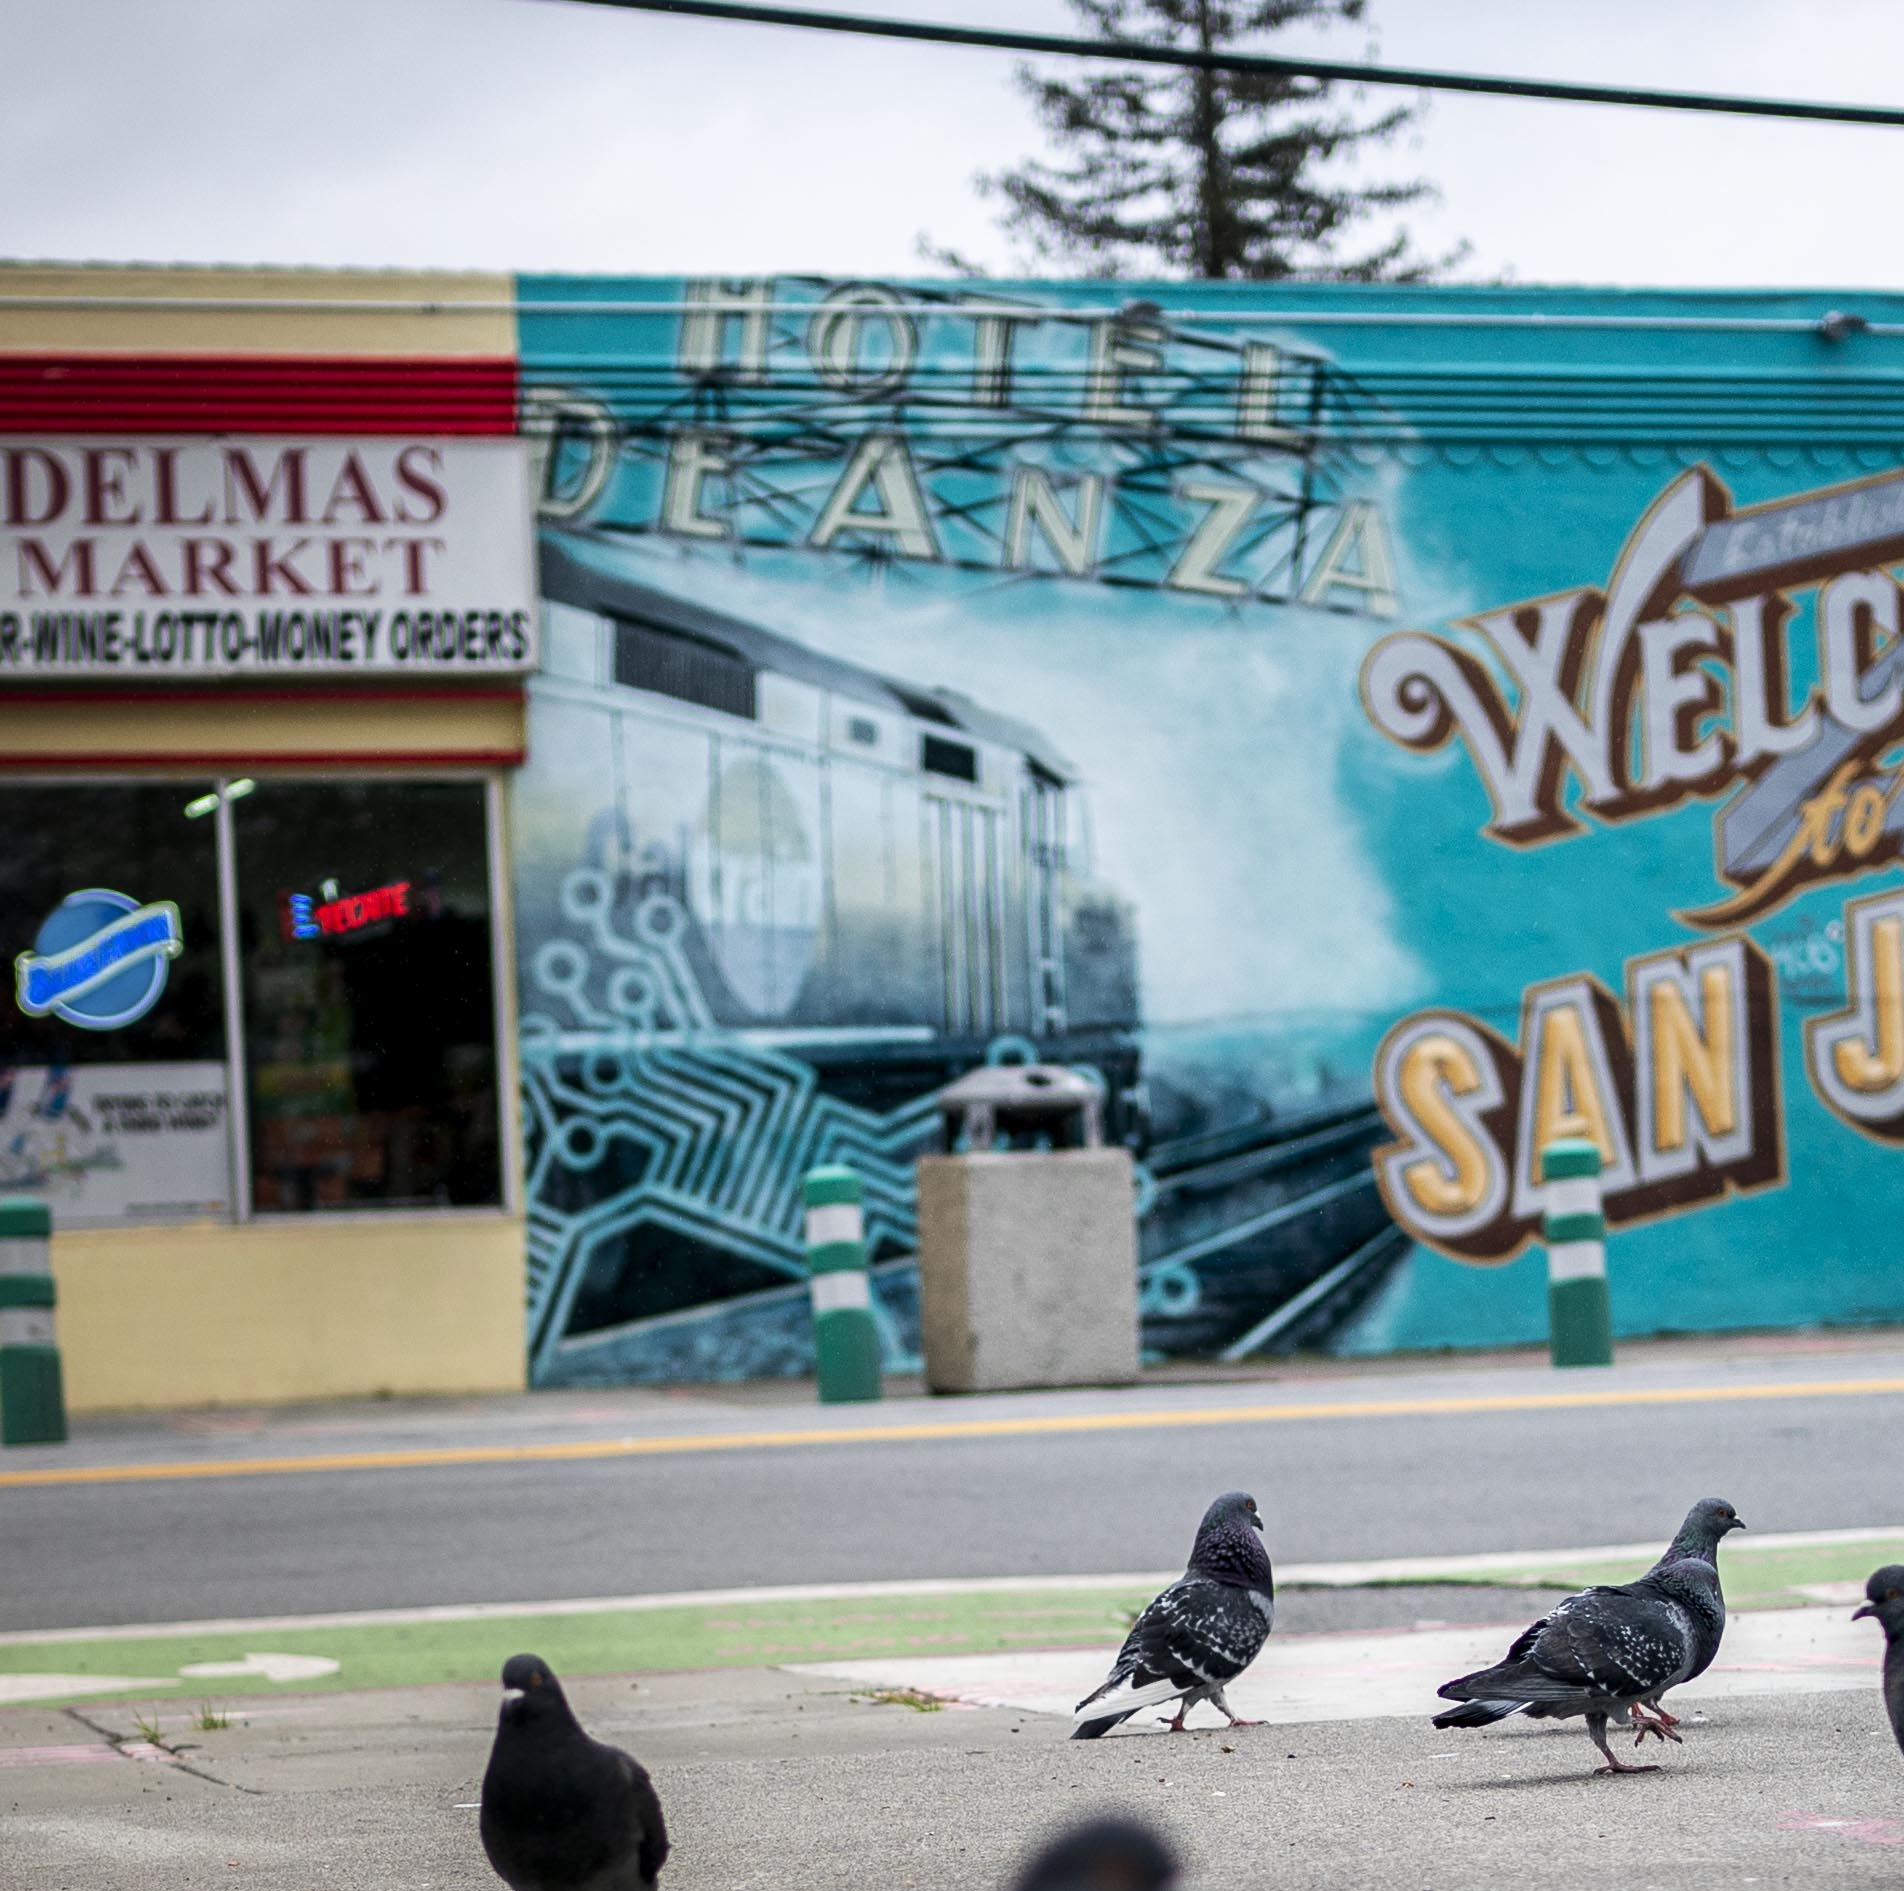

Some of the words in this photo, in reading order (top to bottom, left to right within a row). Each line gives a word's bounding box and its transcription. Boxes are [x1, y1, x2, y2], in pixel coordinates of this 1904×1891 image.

[678, 276, 1308, 447] HOTEL
[0, 444, 450, 529] DELMAS
[17, 537, 447, 601] MARKET
[390, 609, 530, 662] ORDERS
[1372, 933, 1789, 1263] SAN
